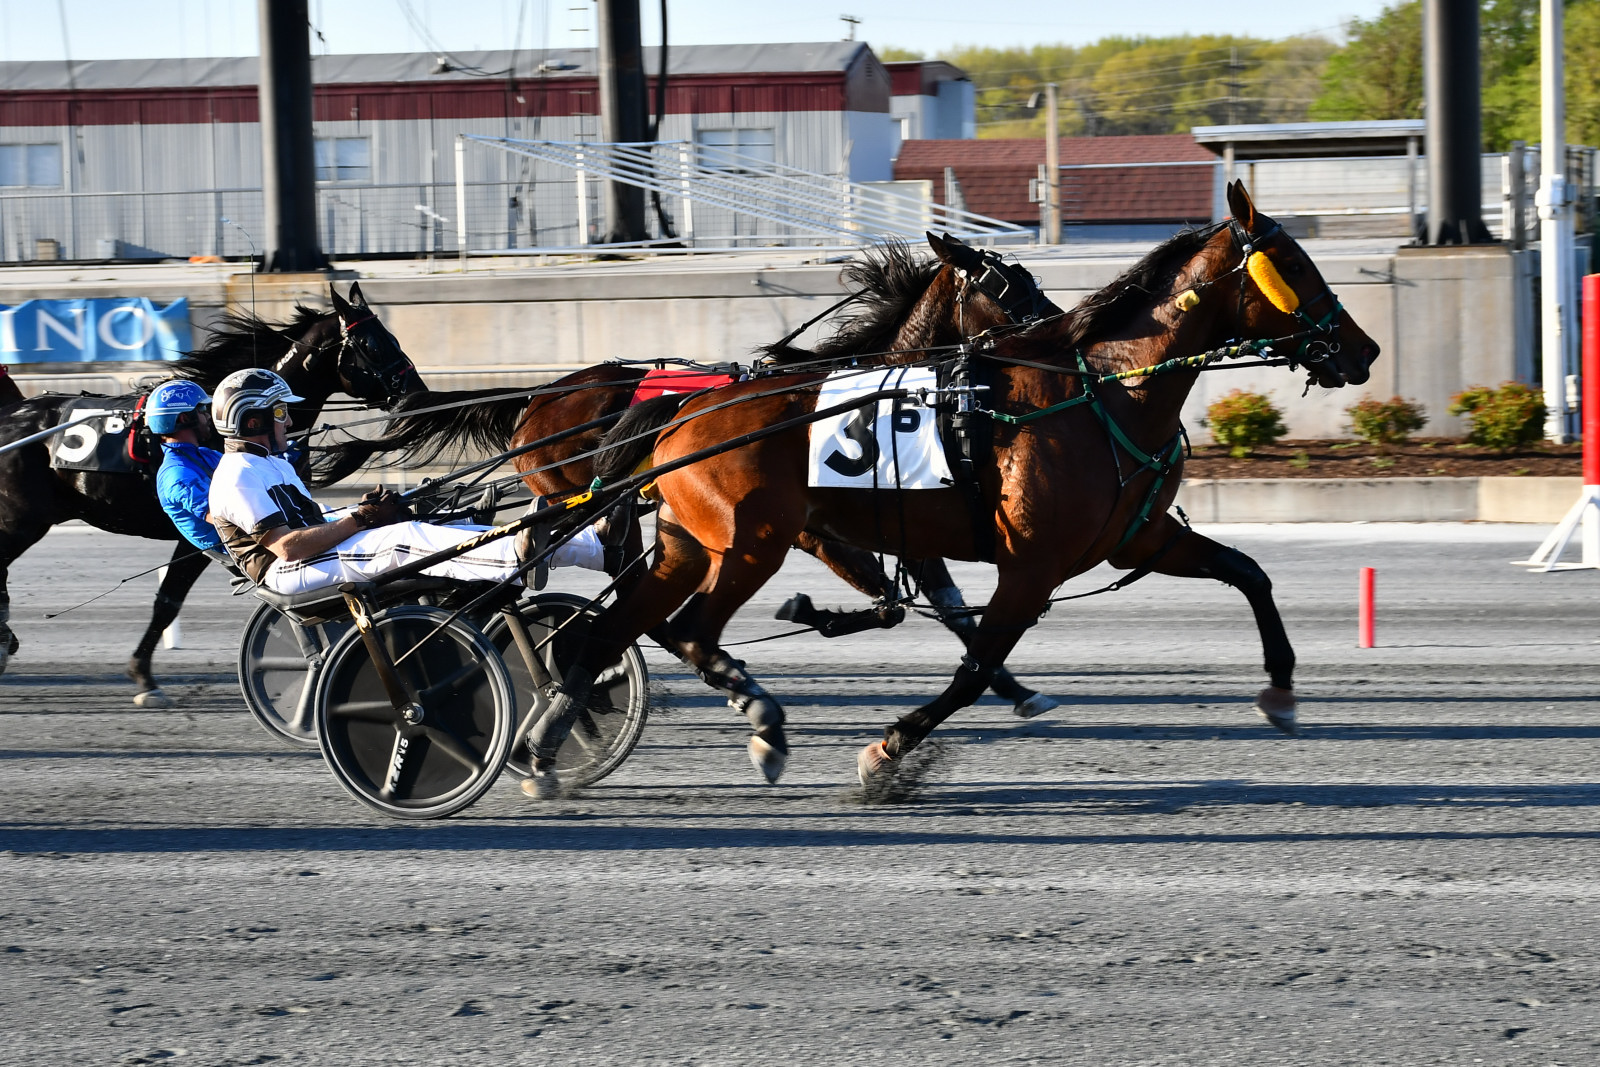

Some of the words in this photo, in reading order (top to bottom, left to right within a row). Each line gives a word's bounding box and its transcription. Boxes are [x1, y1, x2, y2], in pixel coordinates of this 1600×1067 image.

[56, 408, 98, 463] 5
[823, 399, 880, 477] 3
[893, 395, 921, 433] 6
